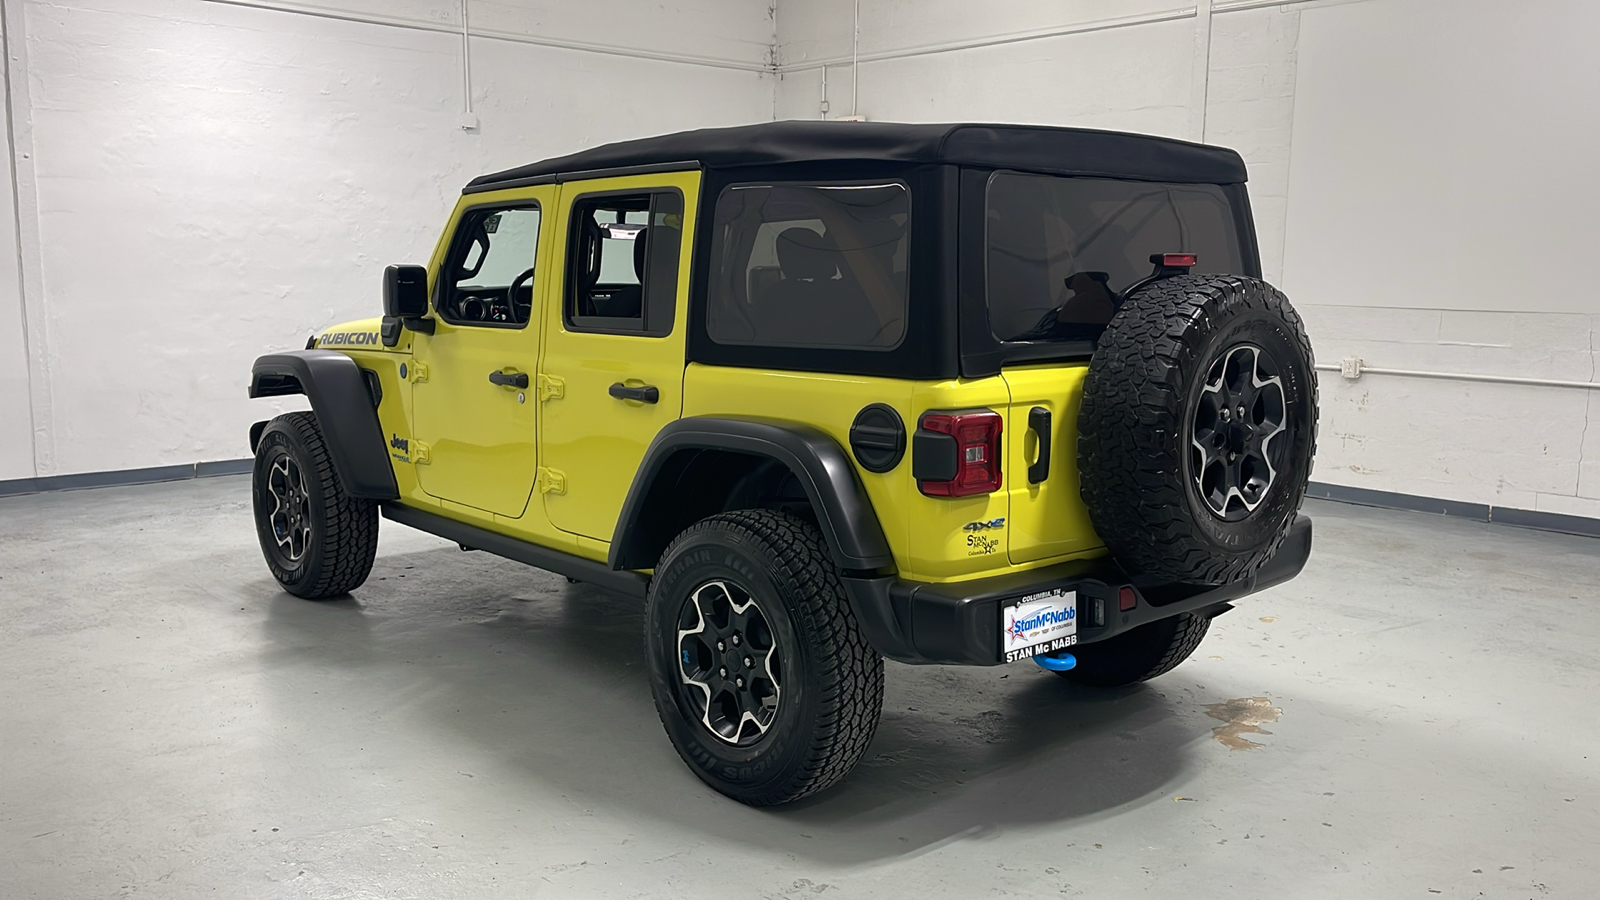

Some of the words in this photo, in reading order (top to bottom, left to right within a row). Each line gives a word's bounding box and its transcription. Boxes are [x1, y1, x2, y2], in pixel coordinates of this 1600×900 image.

[320, 332, 379, 345] RUBICON
[390, 432, 409, 455] Jeep
[1006, 649, 1033, 663] STAN
[1035, 643, 1050, 655] Mc
[1051, 635, 1078, 651] NABB
